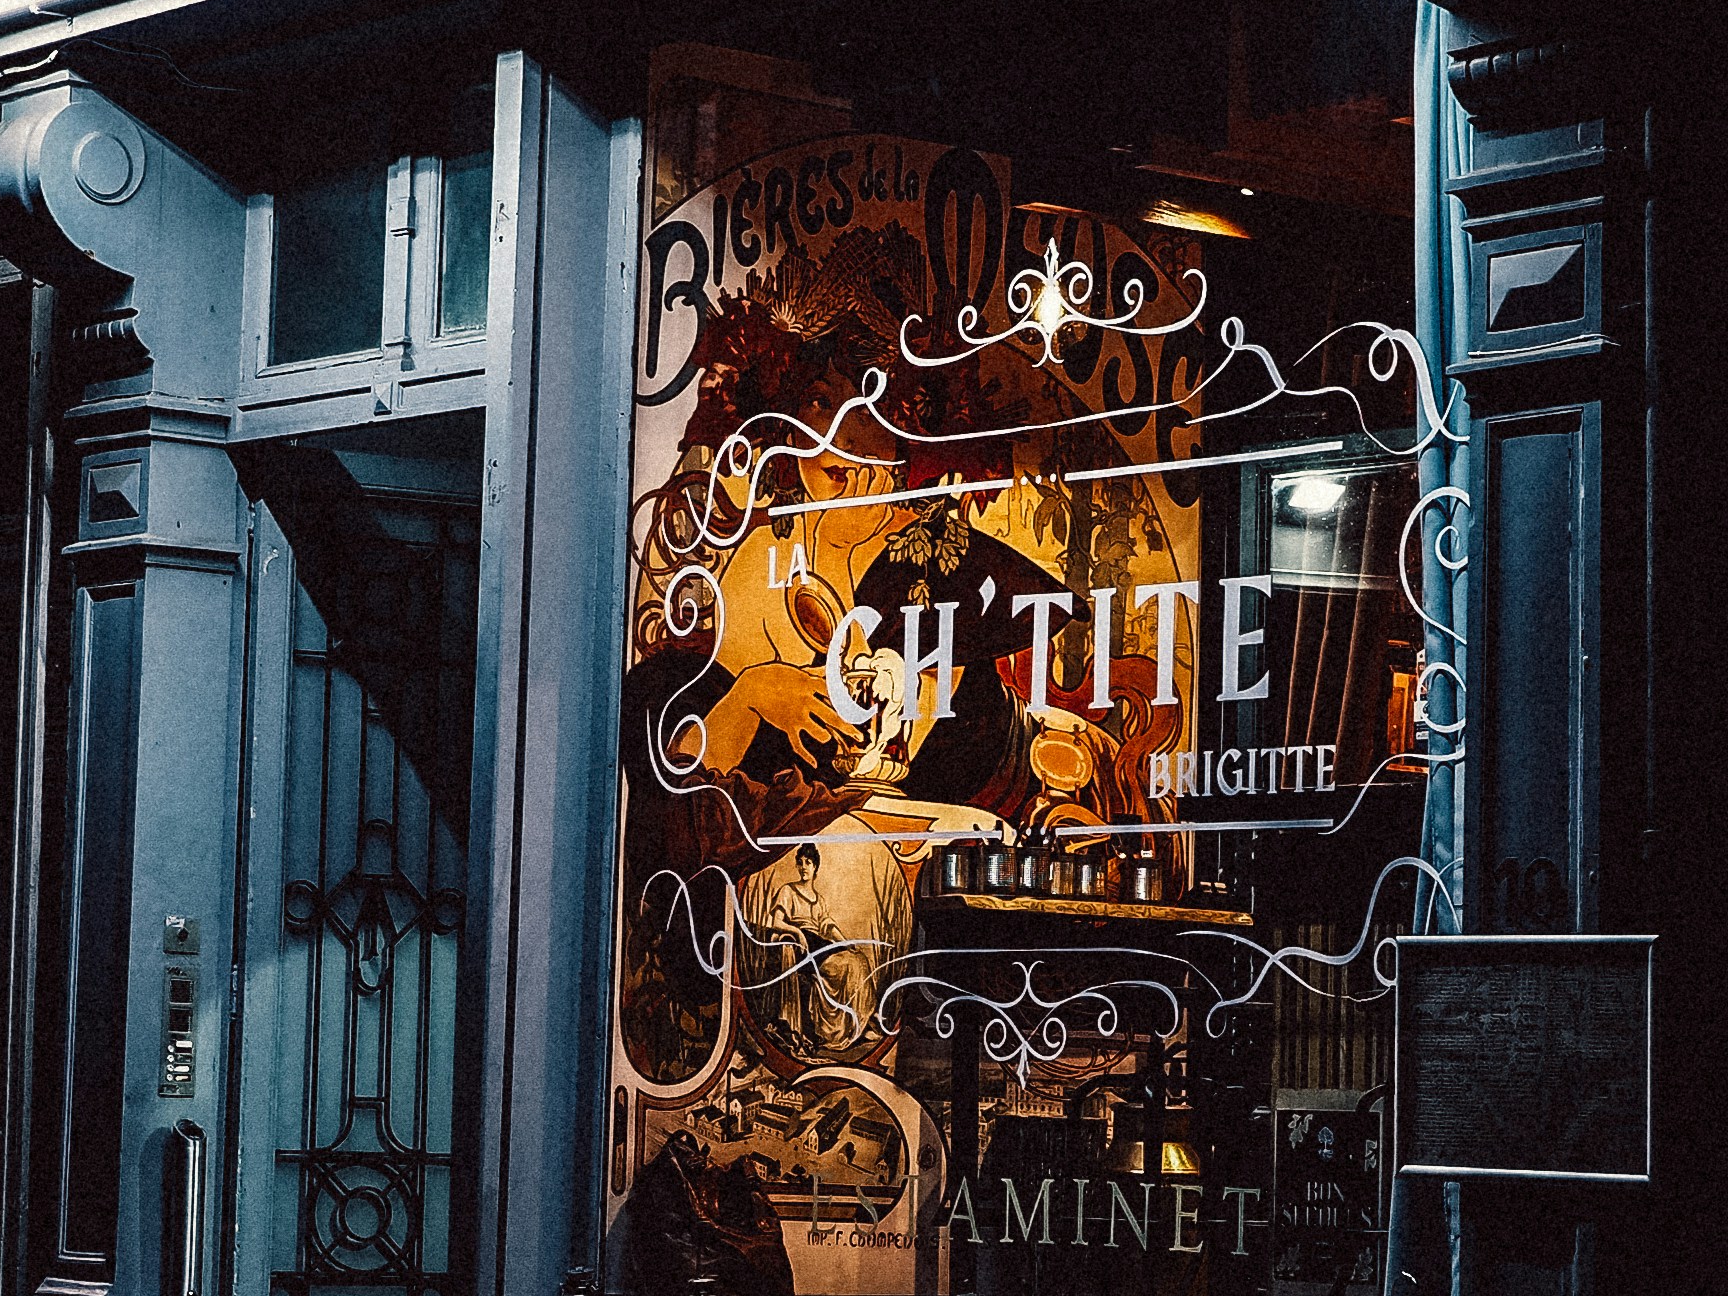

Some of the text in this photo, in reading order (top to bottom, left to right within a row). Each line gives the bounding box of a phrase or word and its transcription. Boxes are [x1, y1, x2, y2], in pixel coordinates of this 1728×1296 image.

[768, 542, 810, 589] LA
[825, 574, 1272, 725] CH'TITE
[1147, 744, 1337, 800] BRIGITTE
